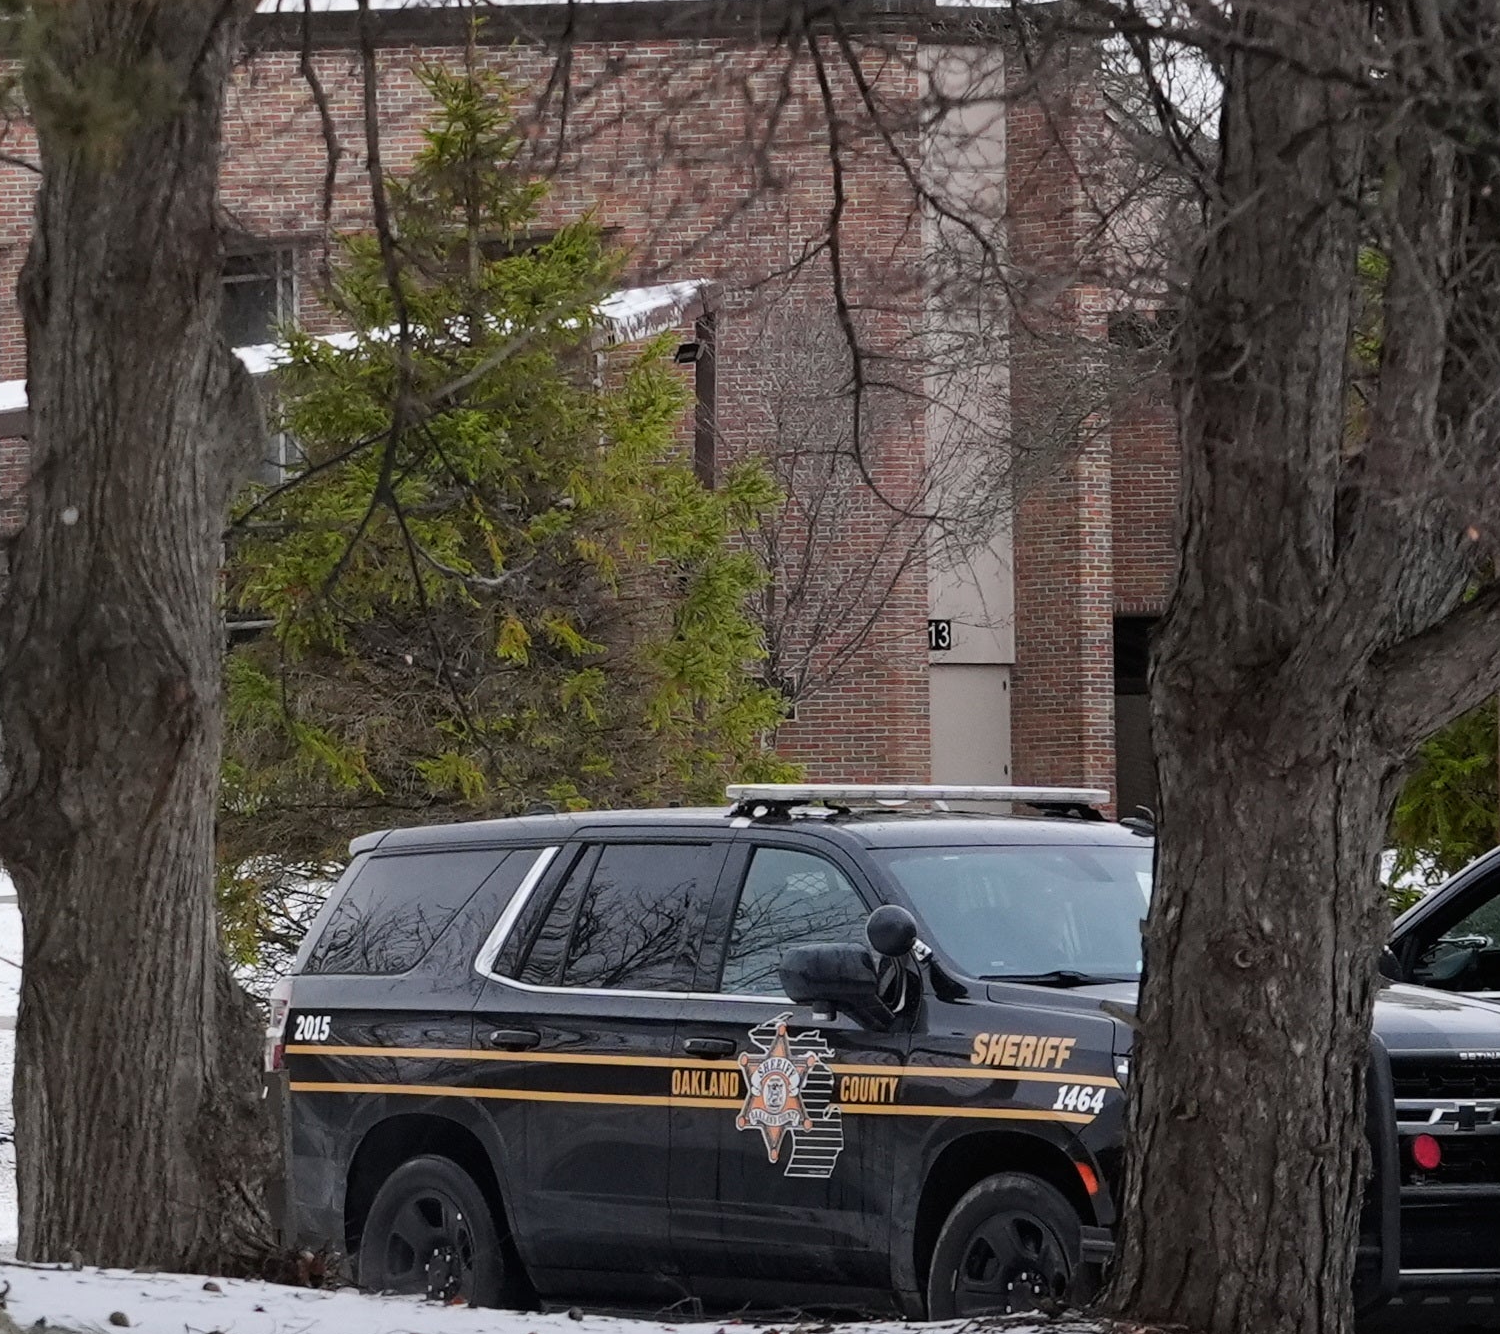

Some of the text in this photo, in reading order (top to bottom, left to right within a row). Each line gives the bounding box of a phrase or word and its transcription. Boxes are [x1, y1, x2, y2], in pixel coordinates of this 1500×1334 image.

[929, 622, 950, 647] 13
[294, 1015, 331, 1041] 2015
[970, 1033, 1076, 1068] SHERIFF
[758, 1057, 797, 1079] SHERIFF
[672, 1069, 899, 1103] OAKLAND COUNTY
[1052, 1085, 1106, 1114] 1464
